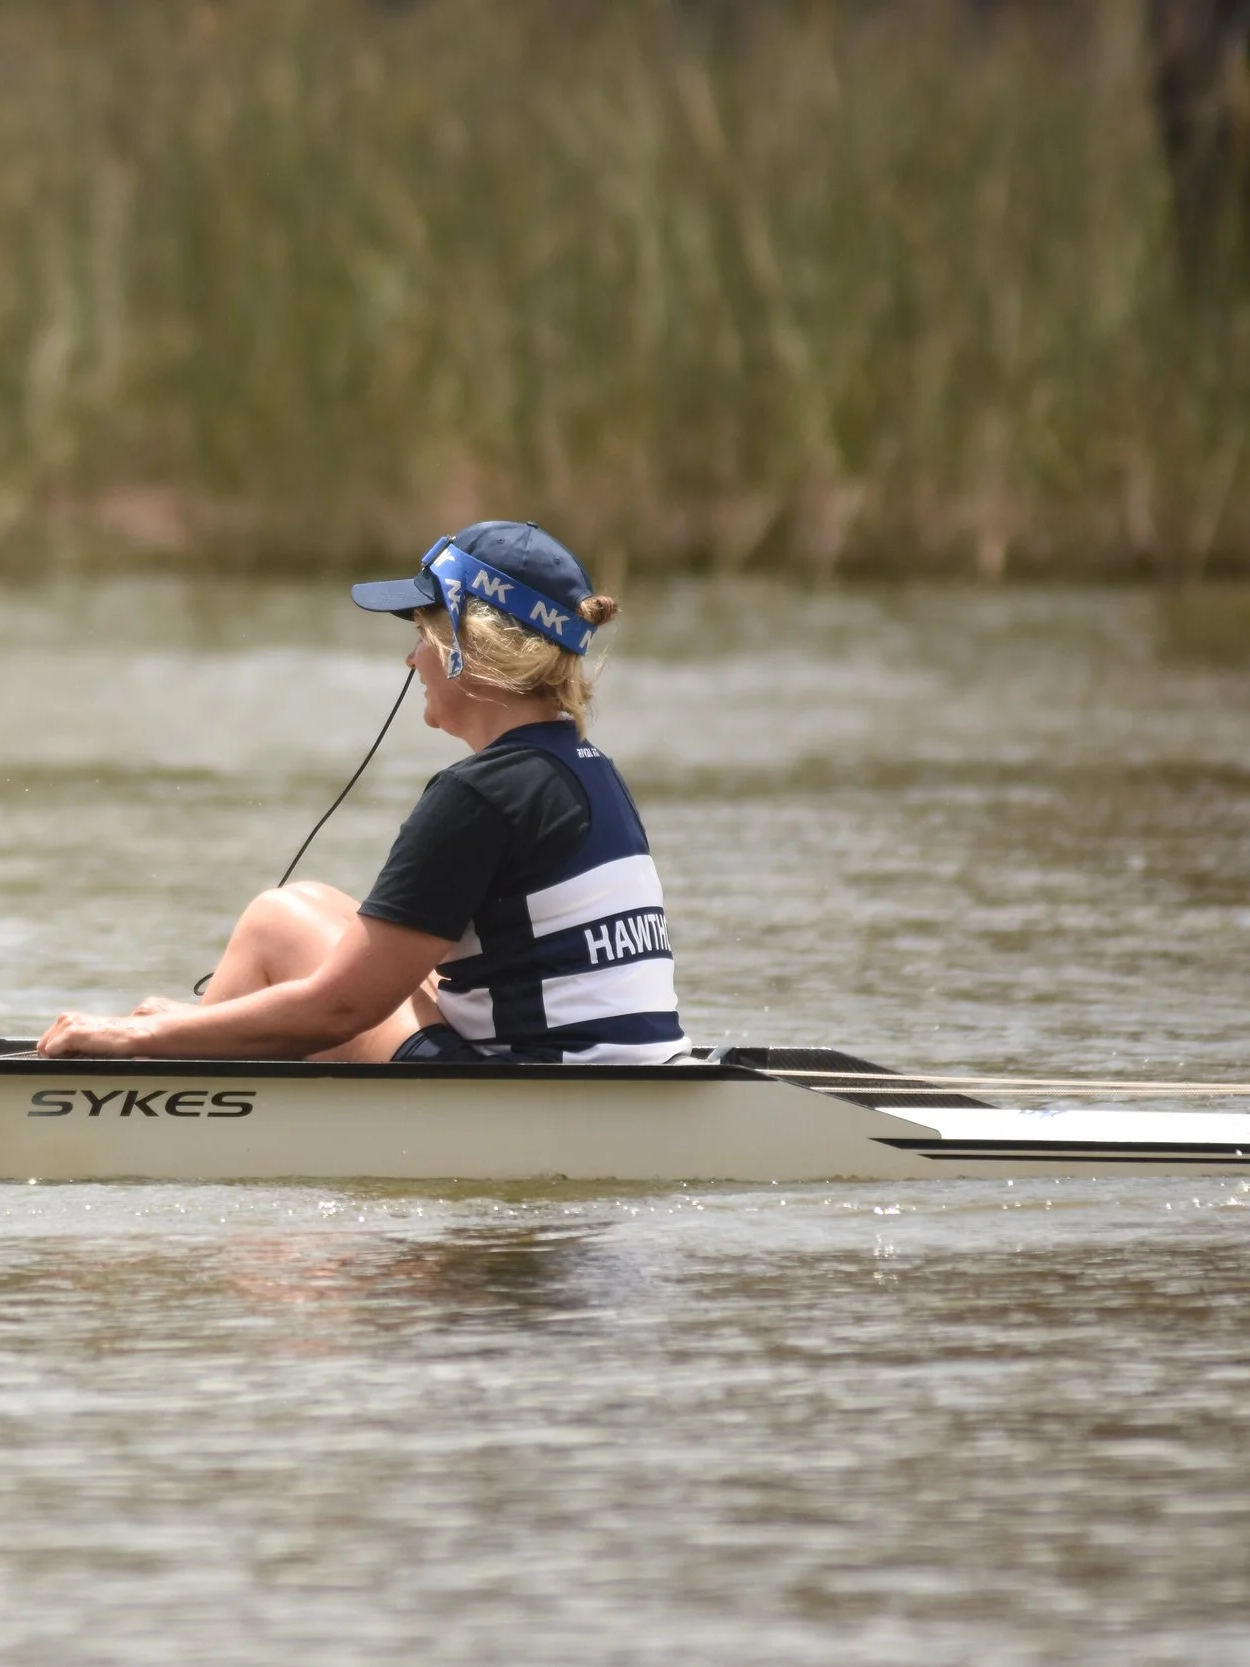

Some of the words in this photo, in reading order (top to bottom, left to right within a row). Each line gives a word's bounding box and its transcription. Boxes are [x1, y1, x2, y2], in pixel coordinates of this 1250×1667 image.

[471, 569, 515, 604] NK
[529, 600, 571, 636] NK
[27, 1089, 257, 1118] SYKES
